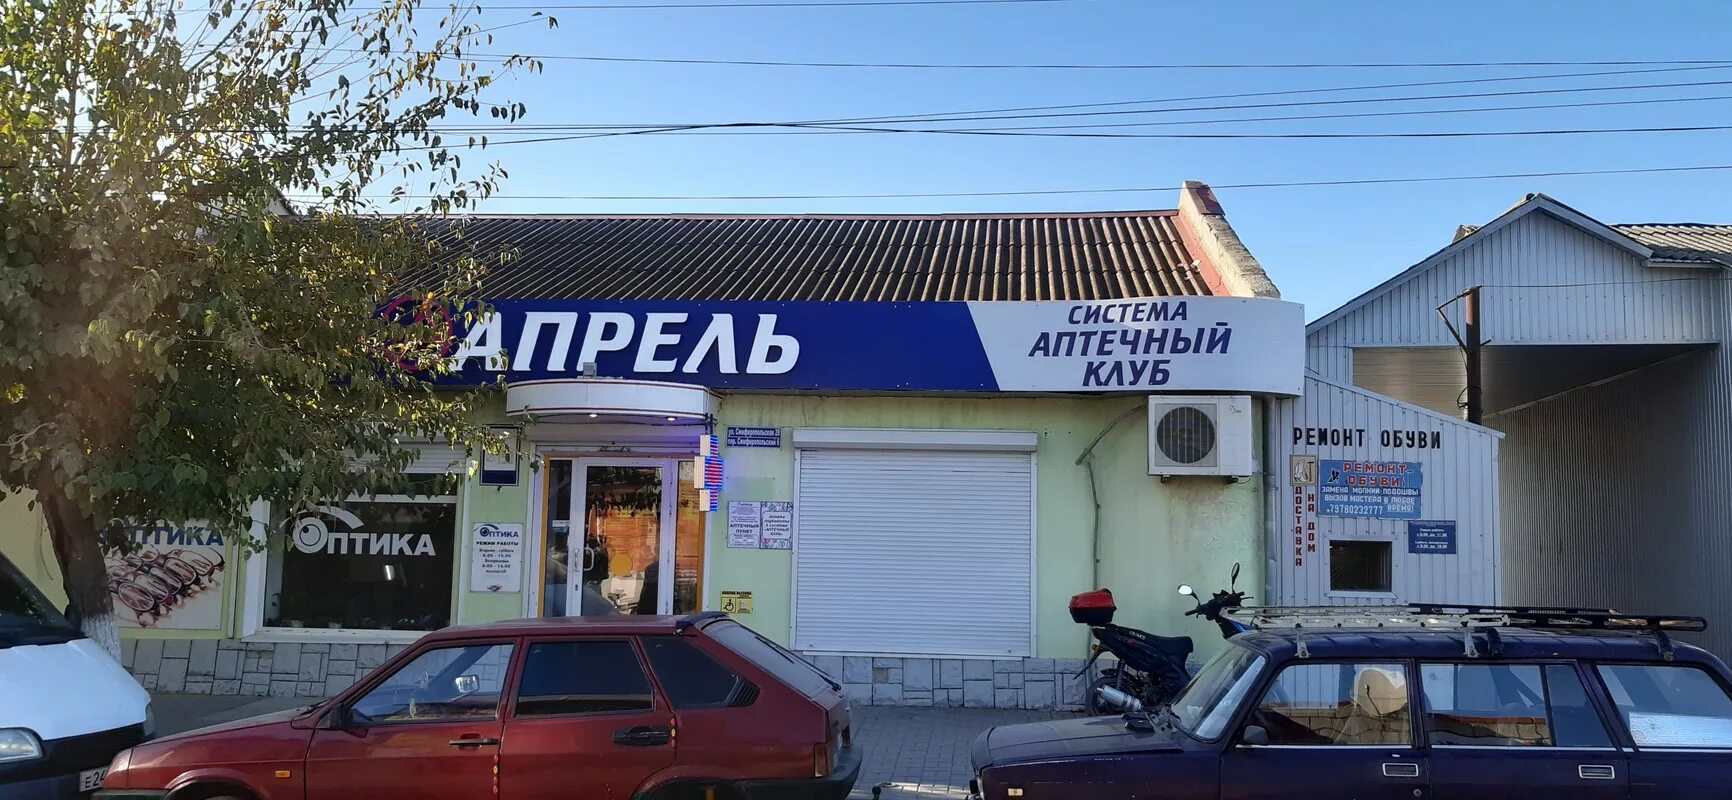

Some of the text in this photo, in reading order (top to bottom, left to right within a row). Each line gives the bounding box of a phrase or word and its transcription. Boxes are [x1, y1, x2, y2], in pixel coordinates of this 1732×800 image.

[1068, 301, 1188, 325] СИСТЕМА
[451, 311, 801, 375] АПРЕЛЬ
[1028, 321, 1233, 357] АПТЕЧНЫЙ
[1082, 359, 1171, 387] КЛУБ
[1293, 427, 1441, 449] РЕМОНТ ОБУВИ
[1321, 486, 1419, 496] ЗАМЕНА МОЛНИИ ПОДОШВЫ
[1346, 475, 1401, 487] ОБУВИ
[1324, 494, 1349, 502] ВЫЗОВ
[1350, 495, 1382, 503] МАСТЕРА
[1391, 497, 1415, 505] ЛЮБОЕ
[1326, 504, 1383, 515] +79780232777
[100, 518, 224, 546] ПТИКА
[293, 516, 436, 556] ОПТИКА
